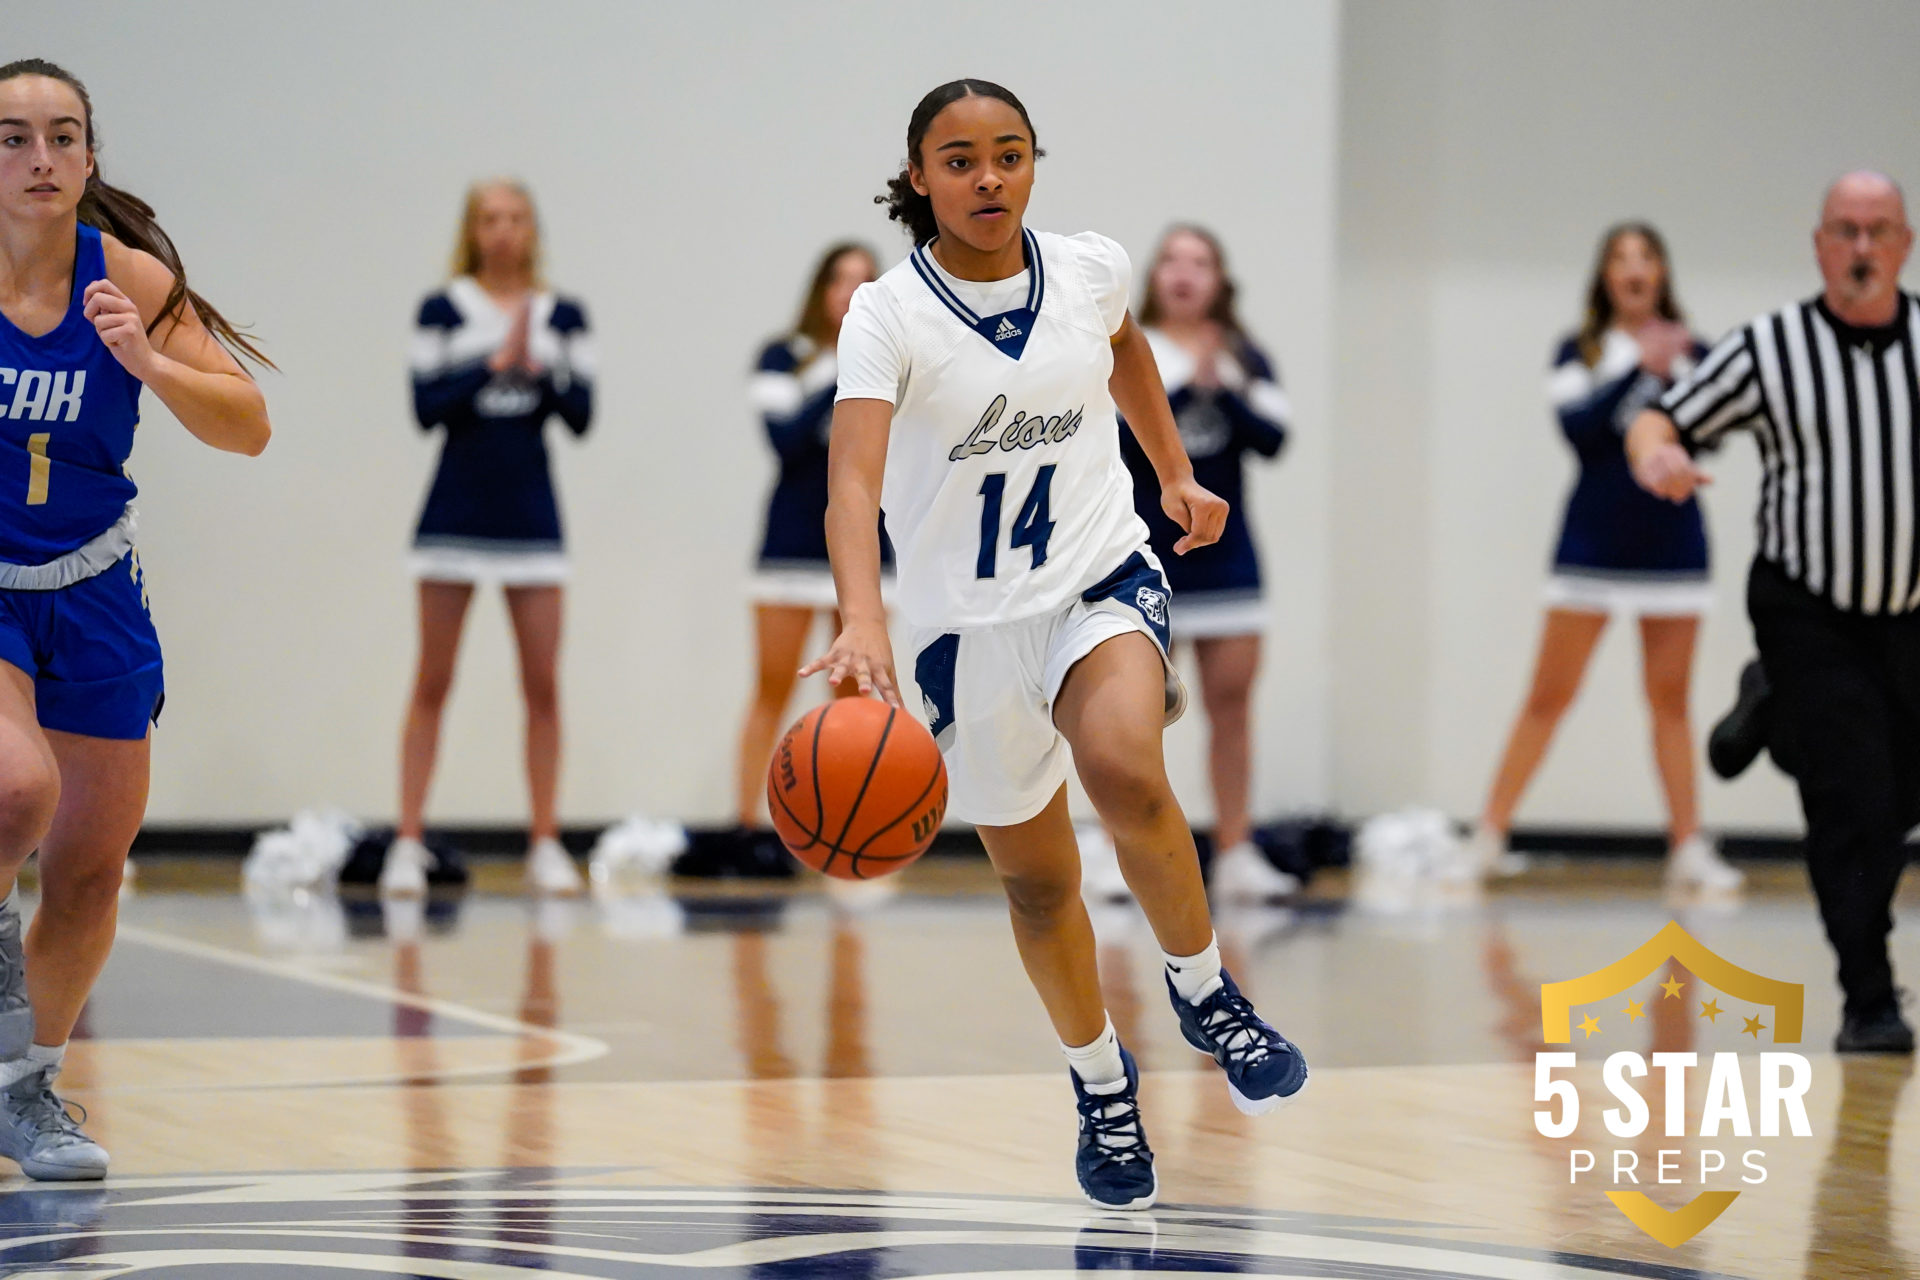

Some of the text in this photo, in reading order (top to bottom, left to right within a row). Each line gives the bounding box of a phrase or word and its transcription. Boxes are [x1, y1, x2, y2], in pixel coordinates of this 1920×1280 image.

[994, 328, 1023, 342] adidas
[26, 432, 51, 505] 1
[976, 462, 1057, 580] 14
